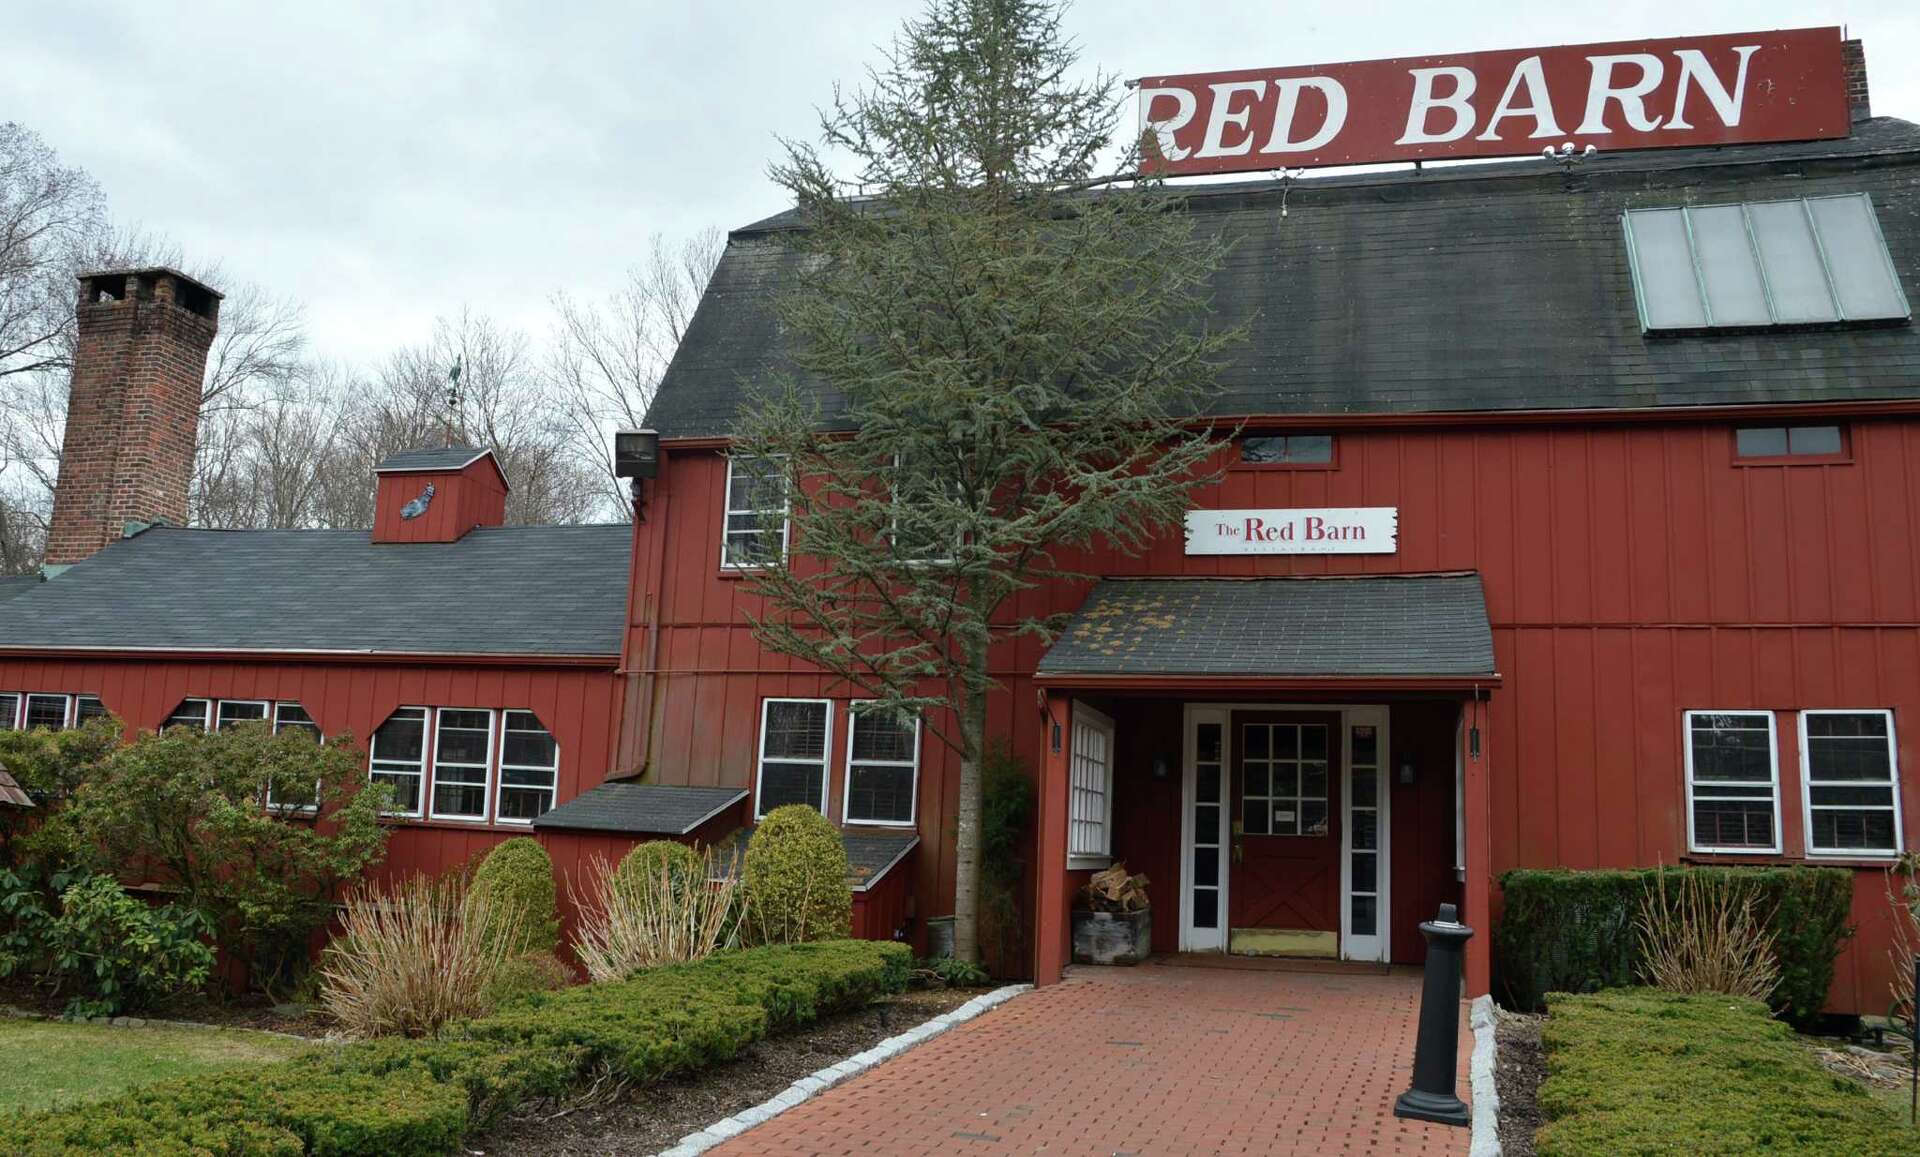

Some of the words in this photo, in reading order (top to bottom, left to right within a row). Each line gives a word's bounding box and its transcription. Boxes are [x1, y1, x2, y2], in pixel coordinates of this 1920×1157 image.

[1139, 76, 1348, 162] RED
[1395, 45, 1762, 145] BARN
[1216, 523, 1239, 536] The
[1244, 518, 1294, 541] Red
[1304, 516, 1366, 541] Barn
